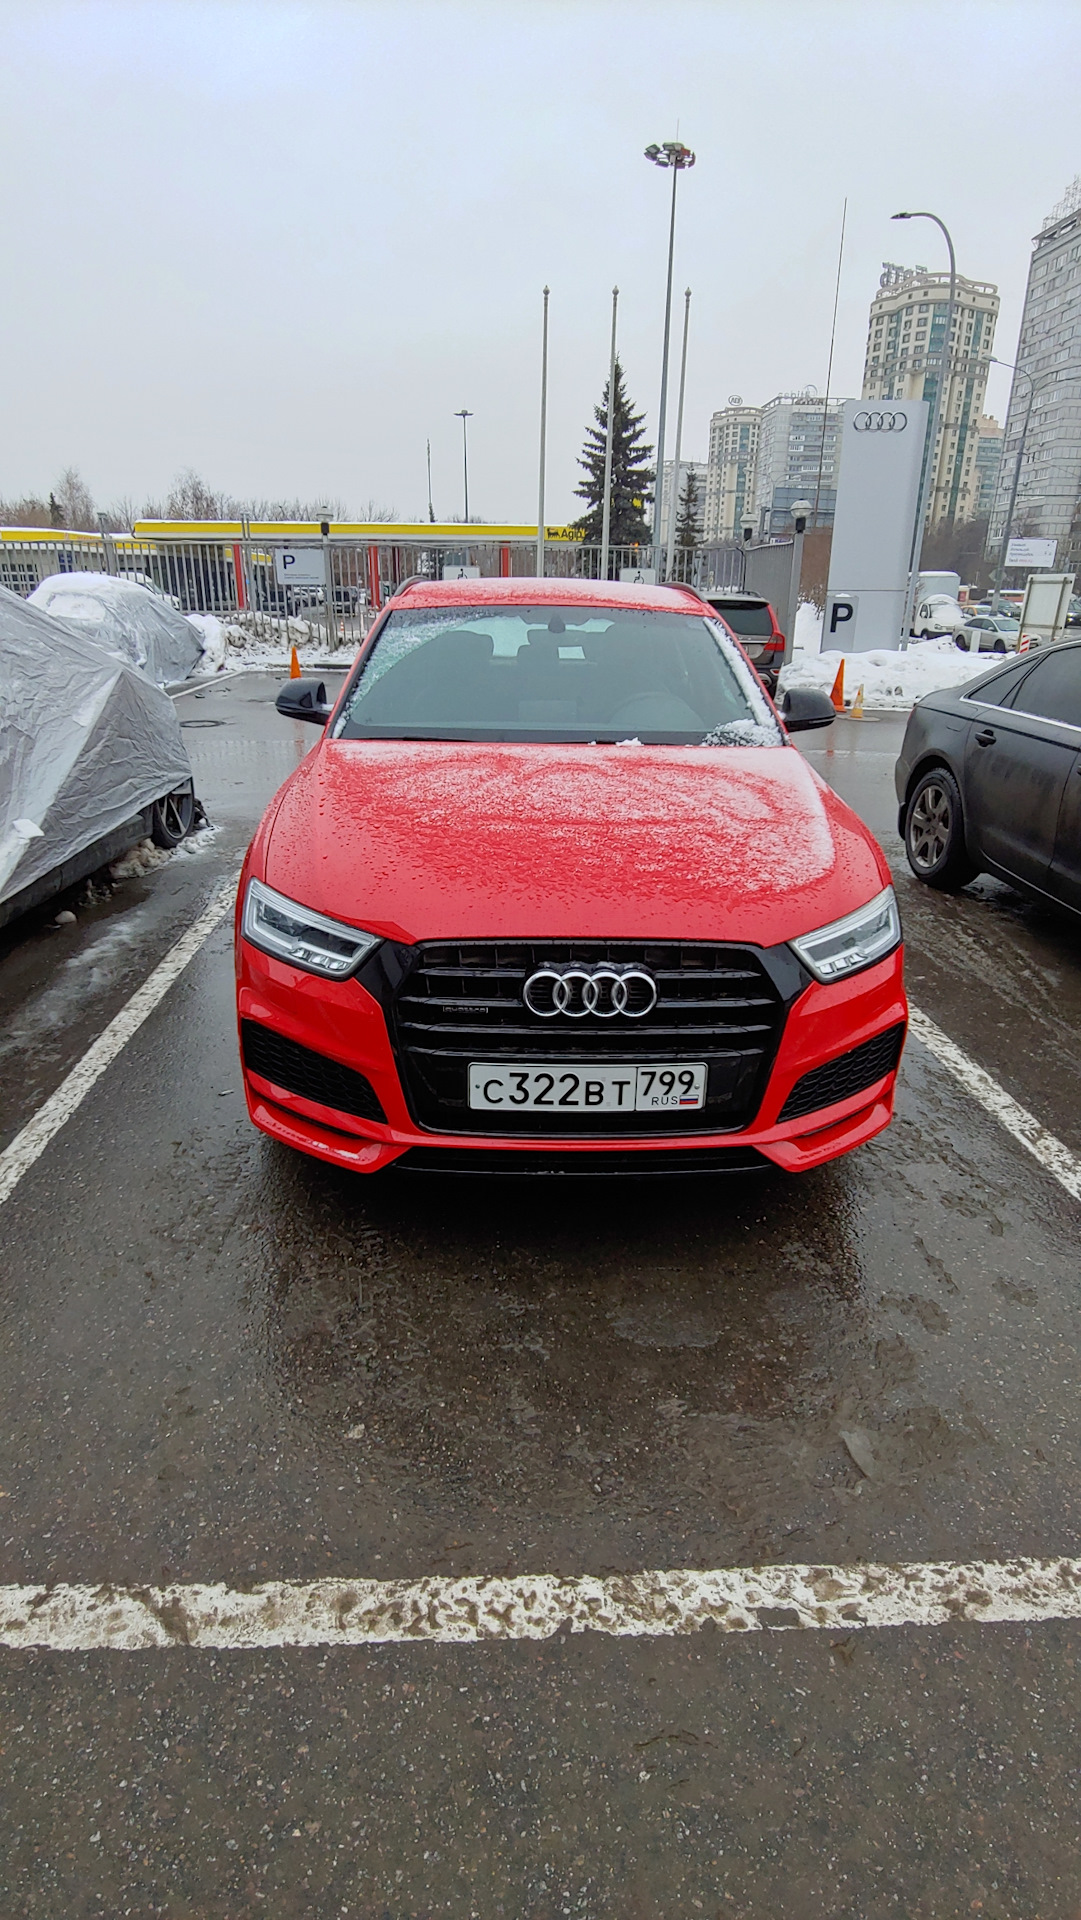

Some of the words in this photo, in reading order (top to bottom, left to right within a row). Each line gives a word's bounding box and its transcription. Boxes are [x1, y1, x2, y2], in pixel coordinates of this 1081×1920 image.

[561, 528, 583, 541] Agip
[283, 554, 296, 570] P
[830, 602, 853, 633] P
[640, 1070, 695, 1097] 799
[651, 1096, 678, 1106] RUS
